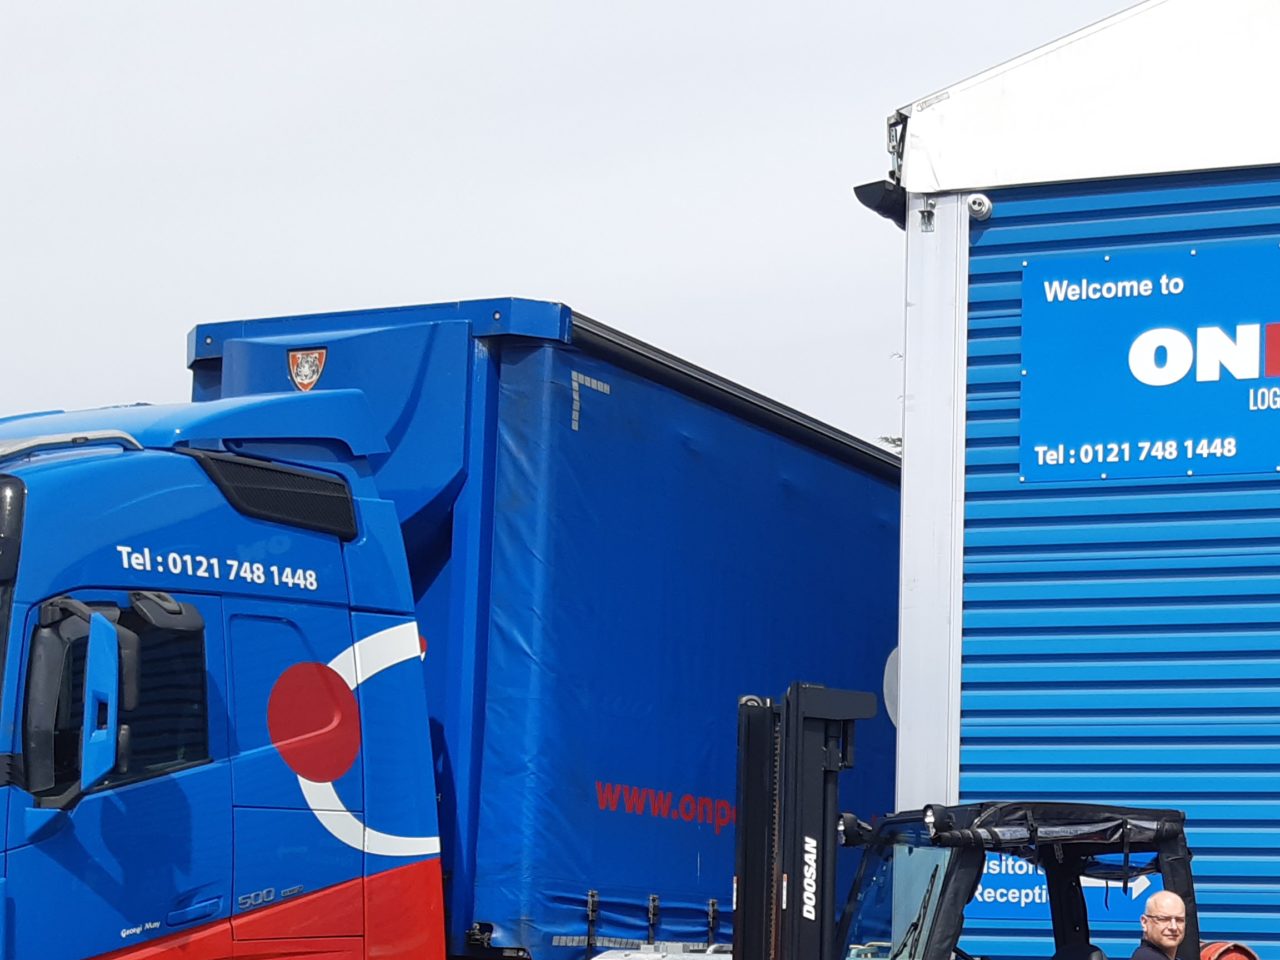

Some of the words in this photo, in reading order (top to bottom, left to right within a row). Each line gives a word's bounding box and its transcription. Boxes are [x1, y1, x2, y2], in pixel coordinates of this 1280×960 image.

[1044, 279, 1153, 302] Welcome
[1160, 274, 1184, 295] to
[1080, 443, 1130, 464] 0121
[1138, 441, 1178, 461] 748
[1184, 438, 1236, 459] 1448
[168, 552, 220, 579] 0121
[226, 559, 265, 584] 748
[270, 565, 318, 590] 1448
[595, 780, 737, 836] www.onp
[802, 836, 817, 920] DOOSAN
[983, 855, 1045, 875] isitor
[238, 887, 275, 908] 500
[974, 883, 1050, 907] Recepti
